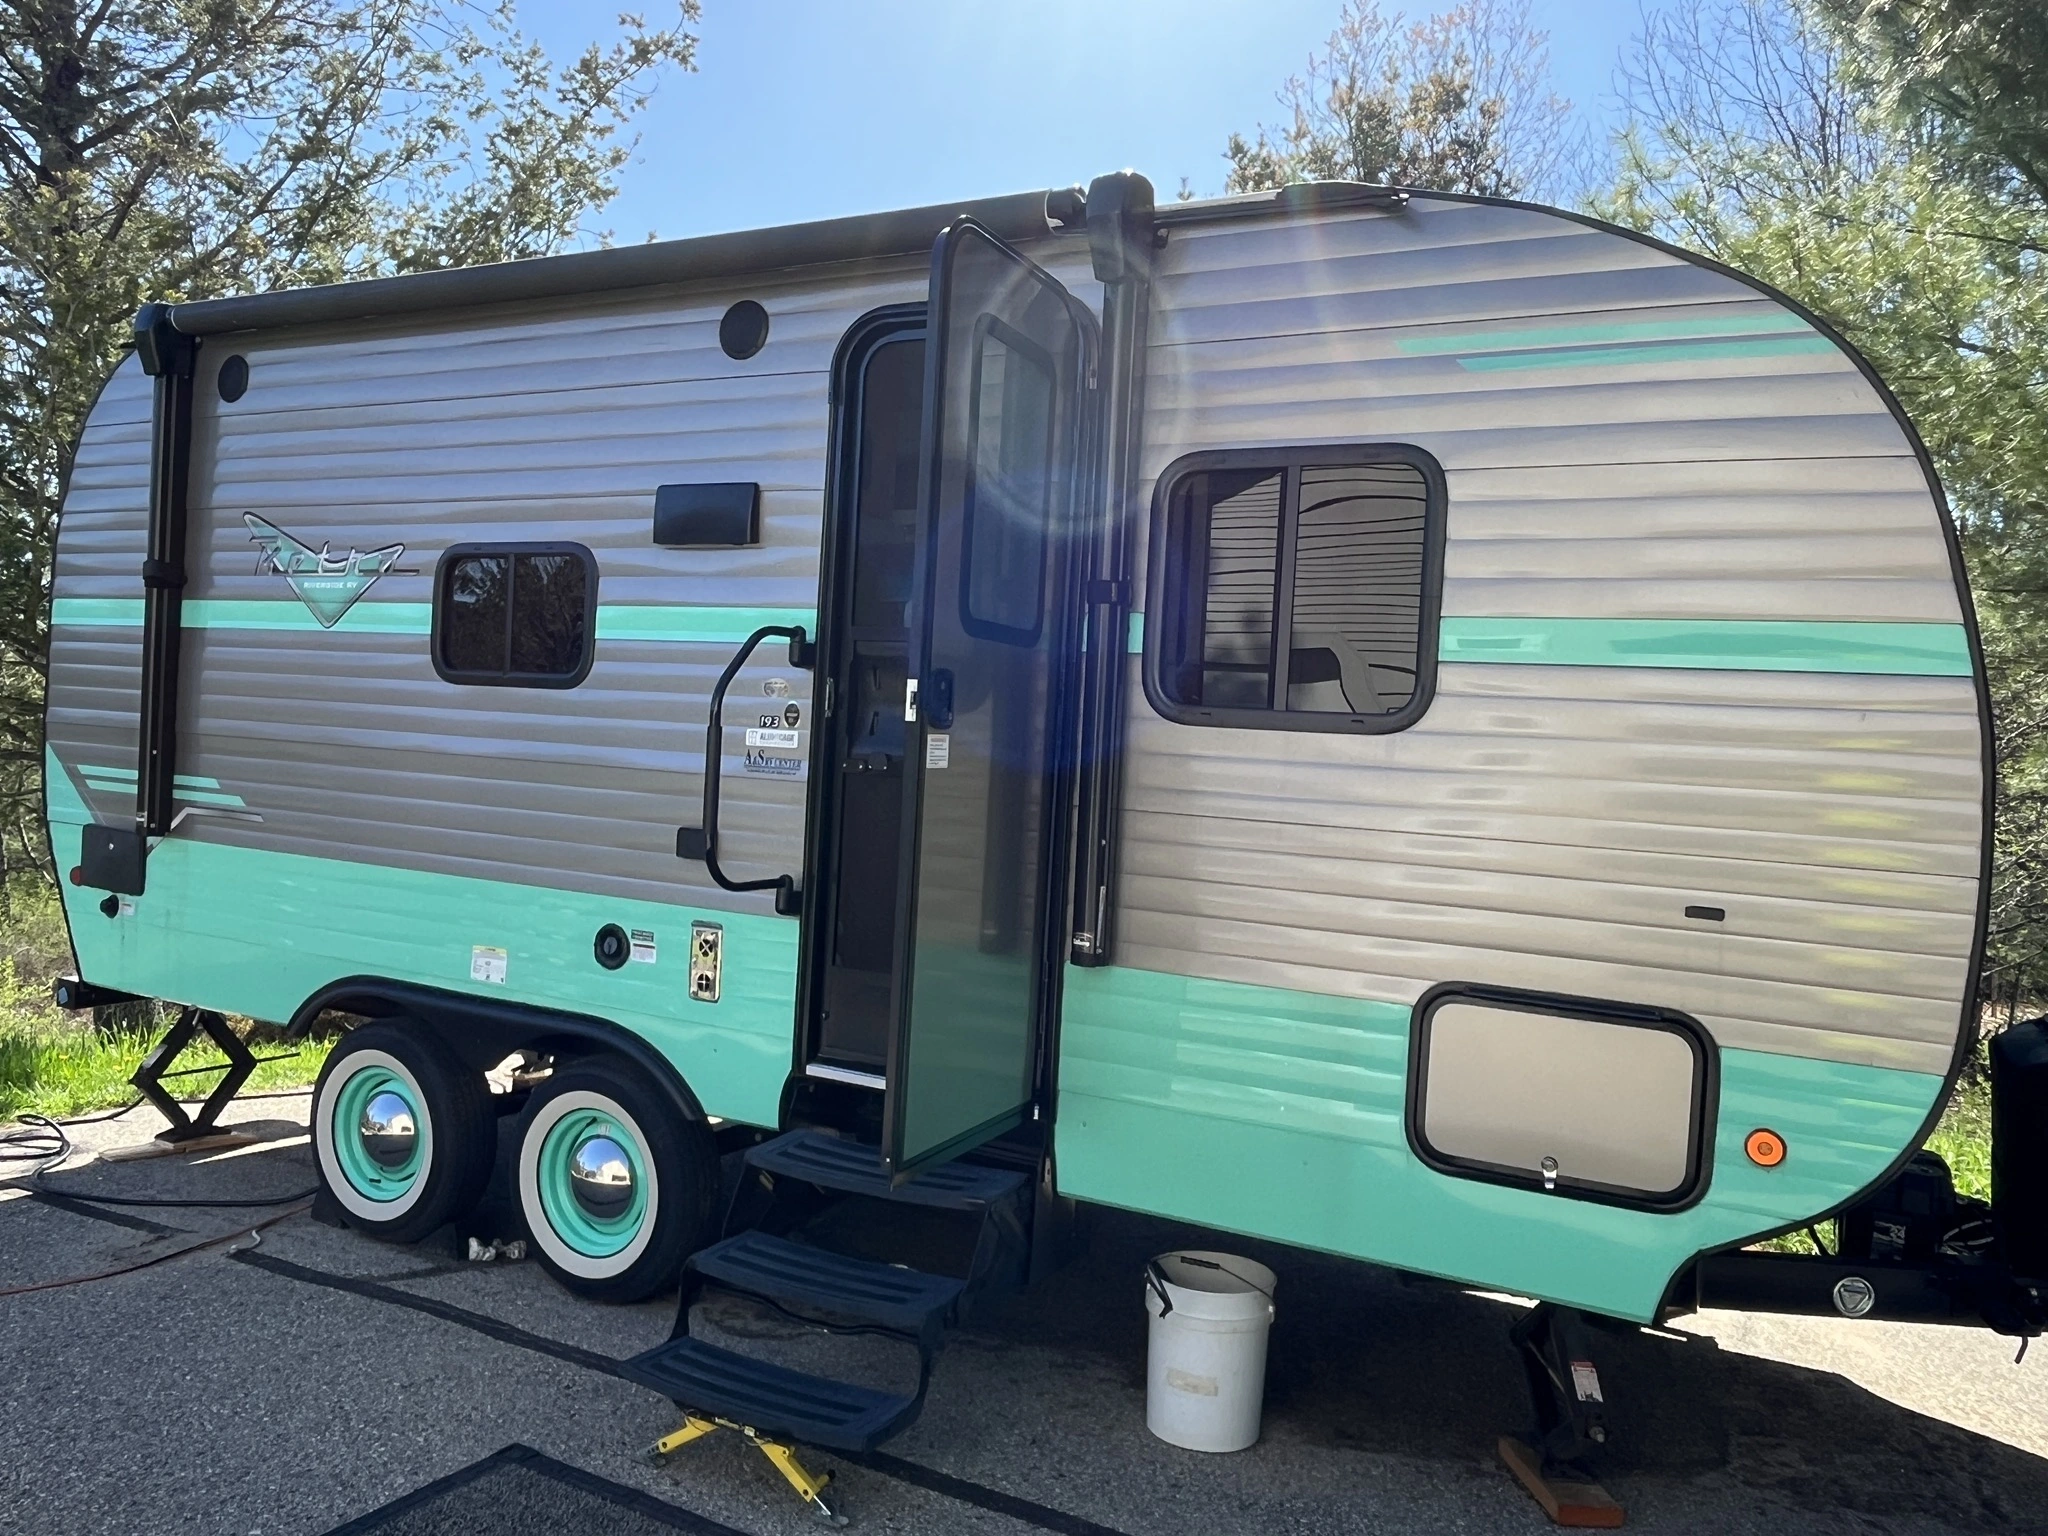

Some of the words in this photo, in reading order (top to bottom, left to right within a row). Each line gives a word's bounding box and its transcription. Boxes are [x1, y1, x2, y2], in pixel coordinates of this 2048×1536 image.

[303, 581, 344, 589] RIVERSIDE
[346, 581, 358, 589] RV
[760, 715, 780, 728] 193
